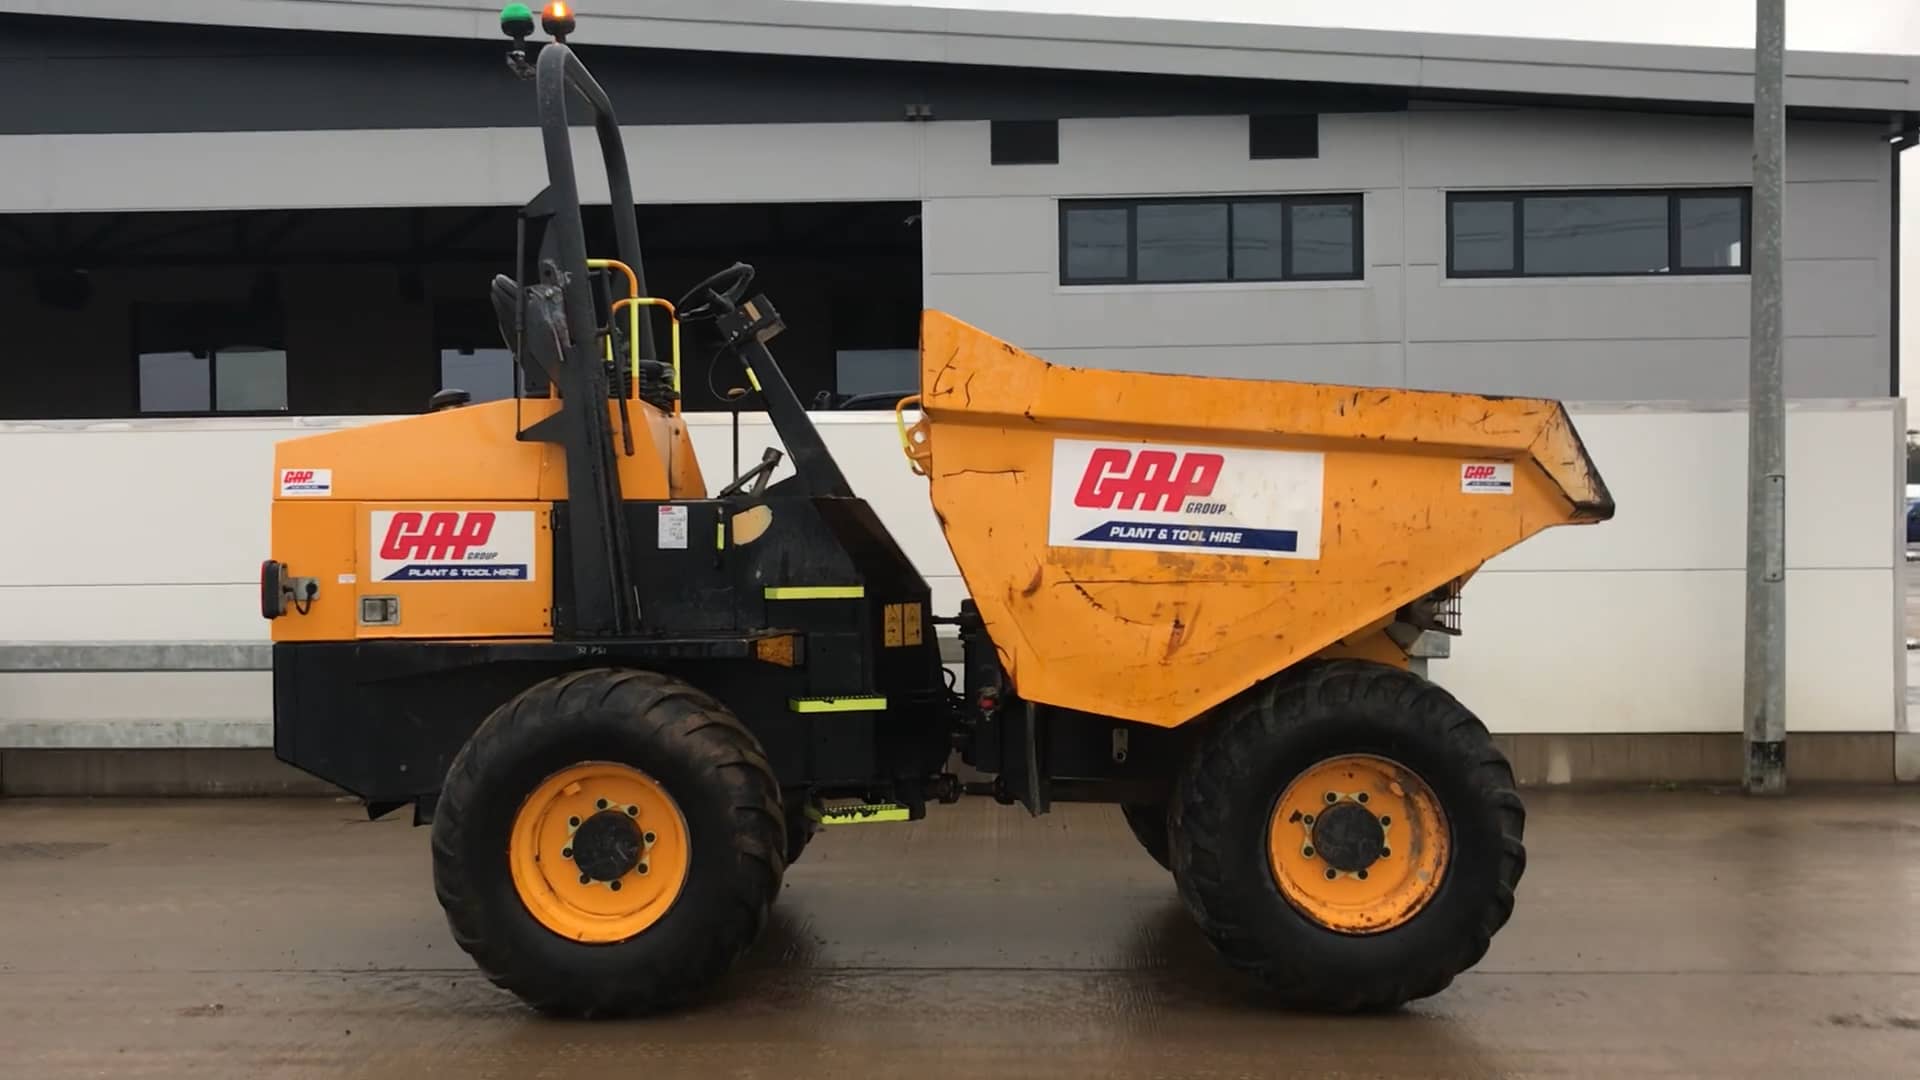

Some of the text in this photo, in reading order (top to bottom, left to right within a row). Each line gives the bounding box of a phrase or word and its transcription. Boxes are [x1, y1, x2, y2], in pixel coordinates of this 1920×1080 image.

[284, 471, 313, 483] GAP
[1464, 466, 1495, 479] GAP
[1074, 448, 1224, 512] GAP
[1186, 502, 1226, 515] GROUP
[380, 512, 496, 560] GAP
[1110, 526, 1242, 543] PLANT & TOOL HIRE
[467, 552, 498, 560] GROUP
[494, 568, 520, 576] HIRE
